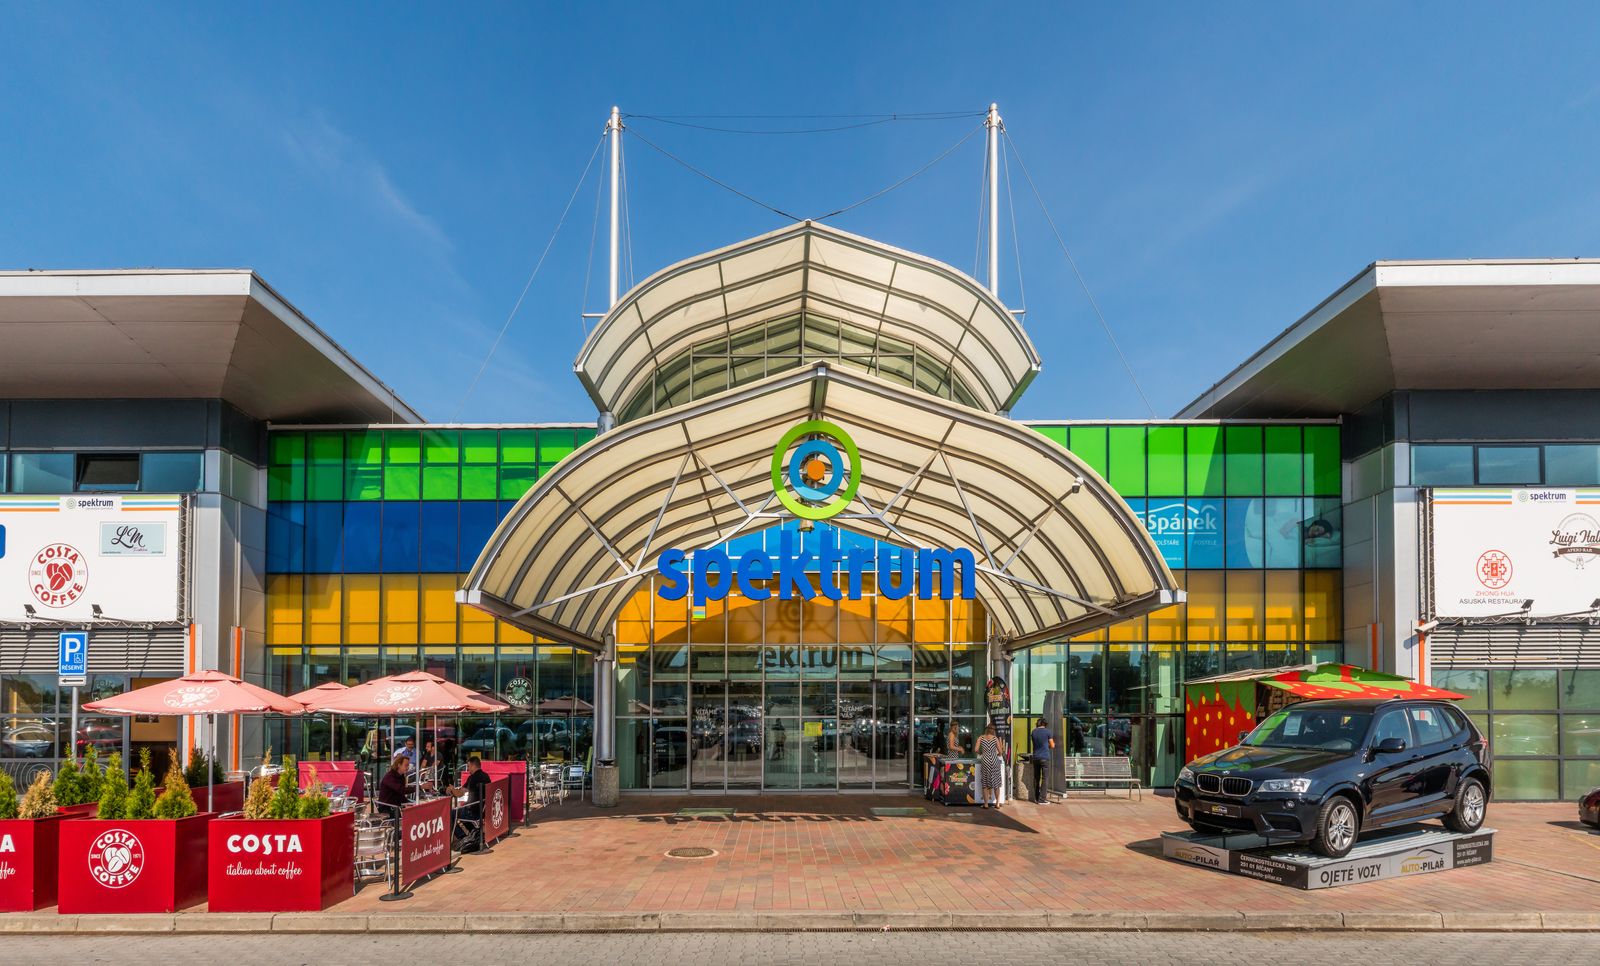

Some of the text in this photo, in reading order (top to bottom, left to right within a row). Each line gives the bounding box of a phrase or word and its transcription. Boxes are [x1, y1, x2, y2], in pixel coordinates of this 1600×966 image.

[78, 498, 114, 508] spektrum
[1530, 492, 1566, 500] spektrum
[111, 526, 146, 548] LM
[1549, 530, 1578, 546] Luigi
[38, 546, 78, 564] COSTA
[657, 530, 976, 618] spektrum
[34, 583, 83, 604] COFFEE
[65, 638, 81, 662] P
[510, 680, 528, 688] COSTA
[508, 696, 530, 706] COFFEE
[410, 816, 444, 842] COSTA
[97, 832, 136, 850] COSTA
[226, 834, 302, 855] COSTA
[94, 864, 139, 884] COFFEE
[226, 861, 302, 880] italian about coffee
[1320, 864, 1382, 886] OJETÉ VOZY
[1401, 858, 1444, 873] AUTO-PILAŘ
